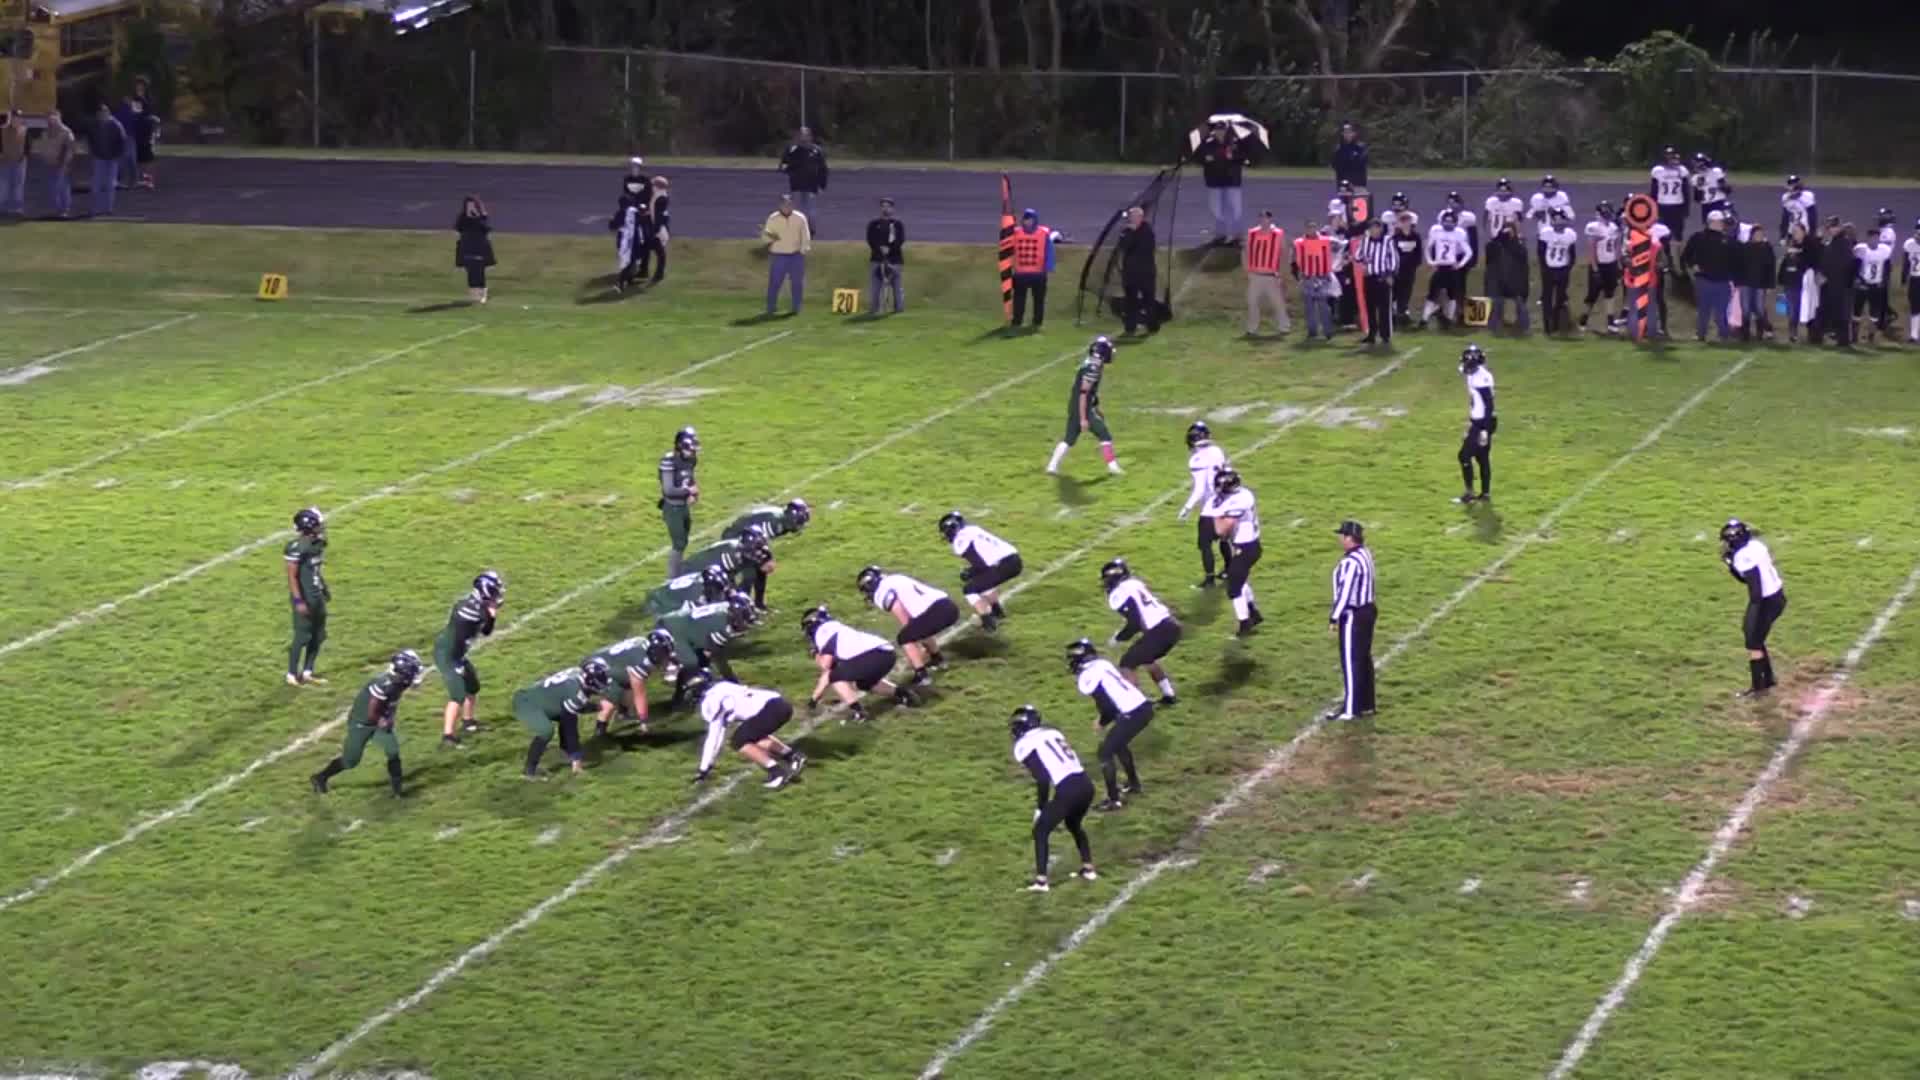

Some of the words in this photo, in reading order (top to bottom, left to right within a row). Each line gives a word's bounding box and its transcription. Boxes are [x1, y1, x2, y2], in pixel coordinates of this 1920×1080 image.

[1439, 244, 1450, 260] 2
[264, 277, 281, 295] 10
[837, 292, 854, 313] 20
[1469, 300, 1487, 322] 30
